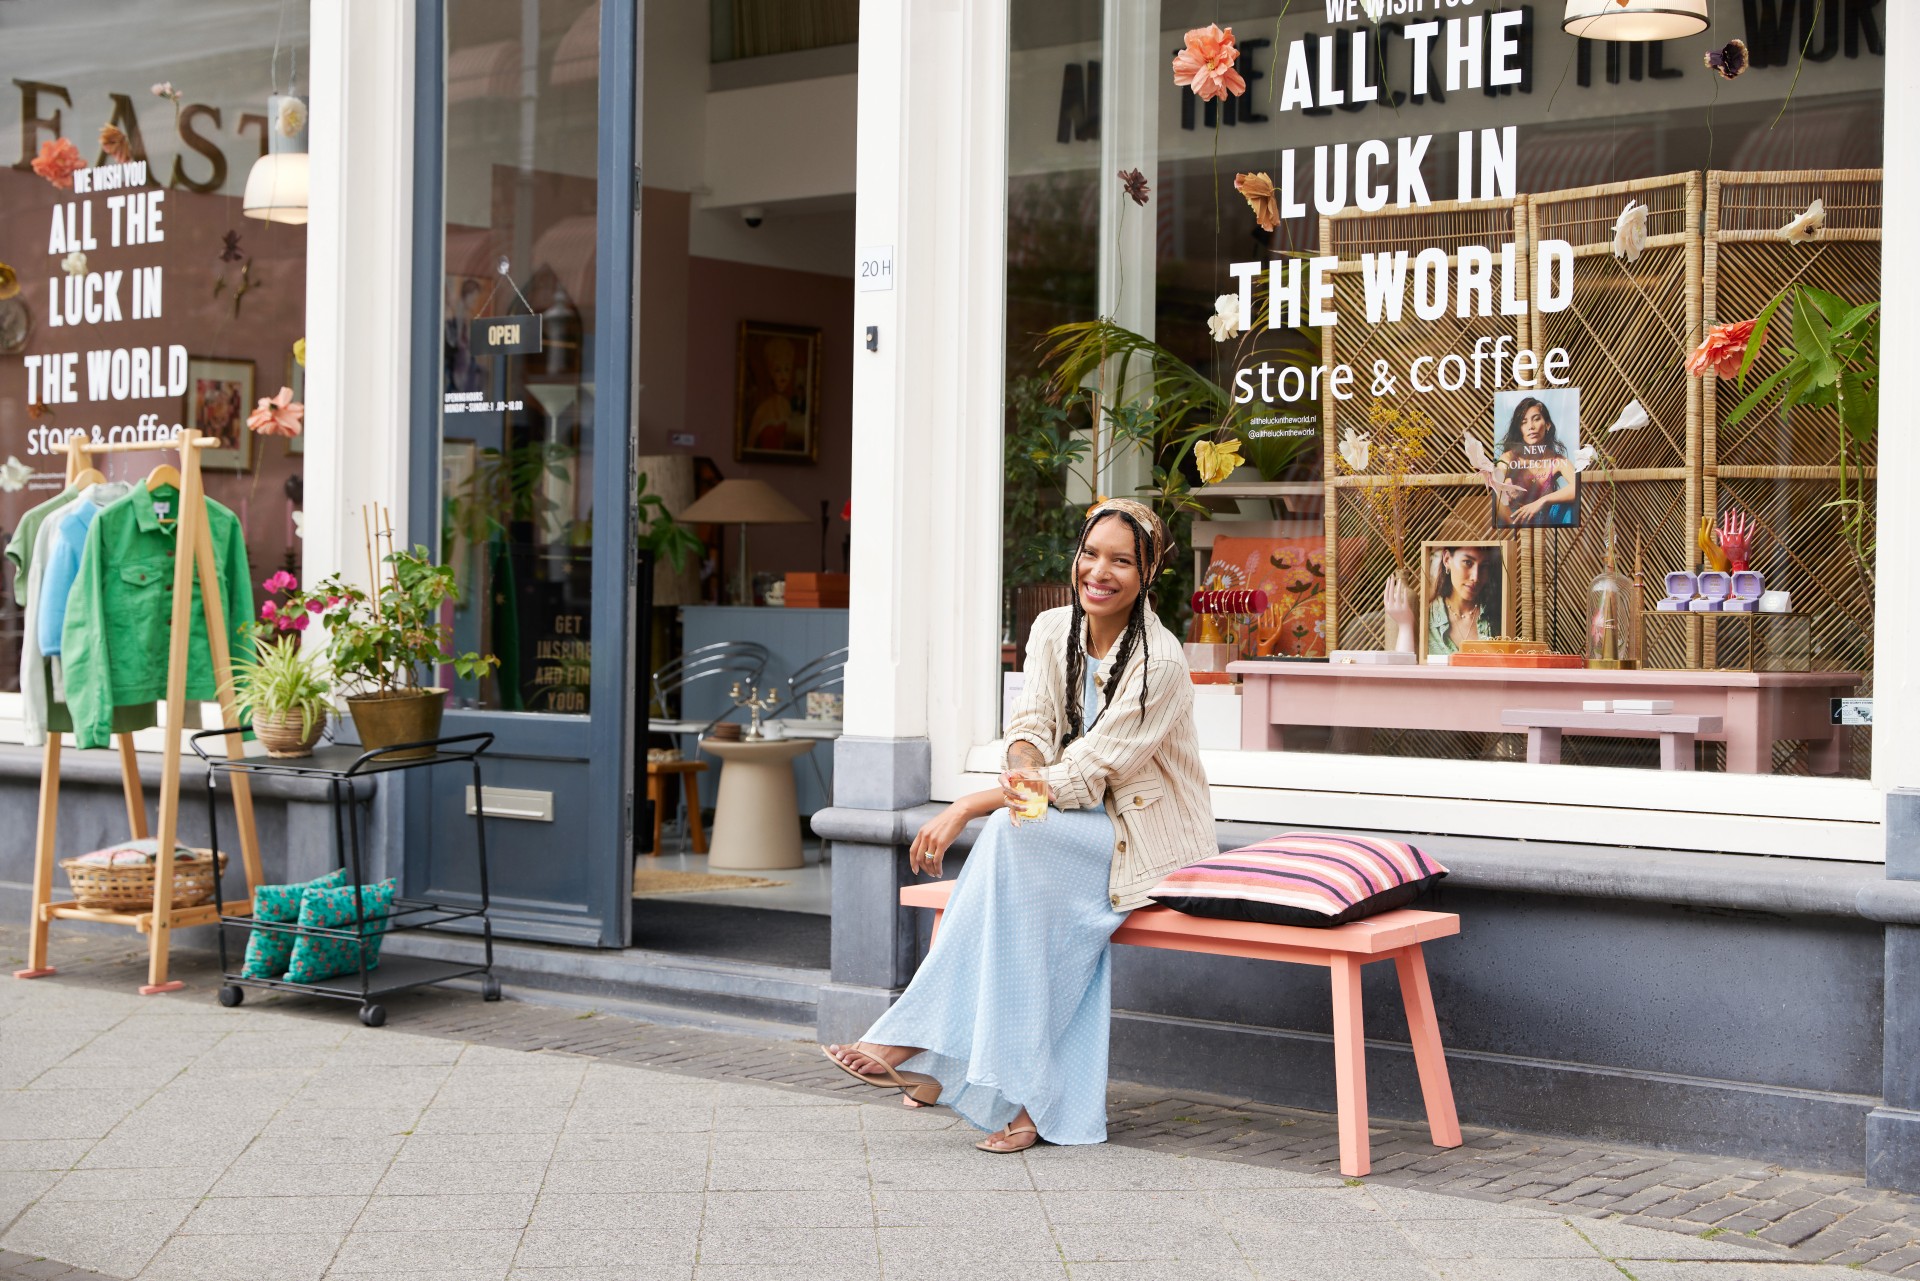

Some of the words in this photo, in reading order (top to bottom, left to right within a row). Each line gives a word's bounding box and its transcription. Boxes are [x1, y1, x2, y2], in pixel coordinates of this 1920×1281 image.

[1279, 30, 1378, 112] ALL
[1404, 9, 1523, 96] THE
[73, 168, 92, 194] WE
[92, 163, 122, 192] WISH
[123, 160, 147, 187] YOU
[1280, 134, 1433, 219] LUCK
[1457, 125, 1517, 204] IN
[48, 200, 97, 254] ALL
[107, 190, 165, 247] THE
[49, 269, 123, 327] LUCK
[132, 265, 163, 320] IN
[861, 260, 879, 277] 20
[882, 259, 891, 276] H
[1229, 255, 1339, 331] THE
[1361, 239, 1575, 323] WORLD
[488, 323, 521, 346] OPEN
[24, 351, 78, 405] THE
[86, 344, 188, 402] WORLD
[1234, 361, 1354, 404] store
[1370, 359, 1398, 397] &
[1409, 335, 1571, 394] coffee
[1523, 444, 1547, 455] NEW
[554, 614, 583, 635] GET
[547, 692, 586, 711] YOUR
